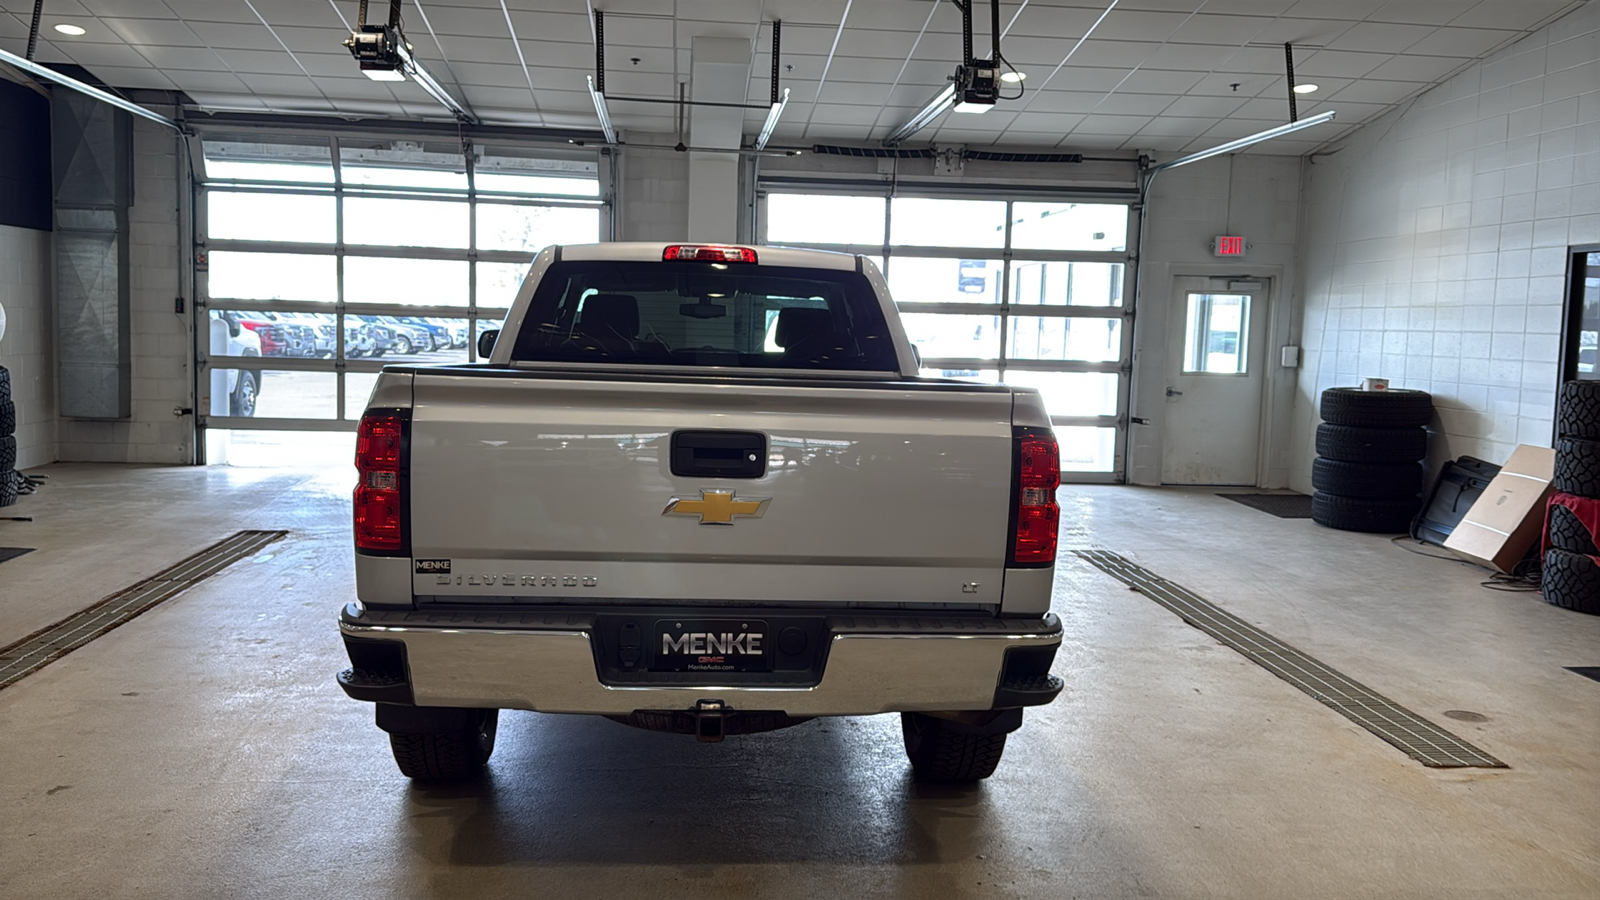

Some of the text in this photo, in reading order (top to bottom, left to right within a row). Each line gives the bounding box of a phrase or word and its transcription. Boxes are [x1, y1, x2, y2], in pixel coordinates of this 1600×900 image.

[1220, 236, 1243, 254] EXIT
[416, 561, 450, 569] MENKE
[436, 573, 598, 587] SILVERADO
[962, 582, 981, 593] LT
[662, 632, 763, 655] MENKE
